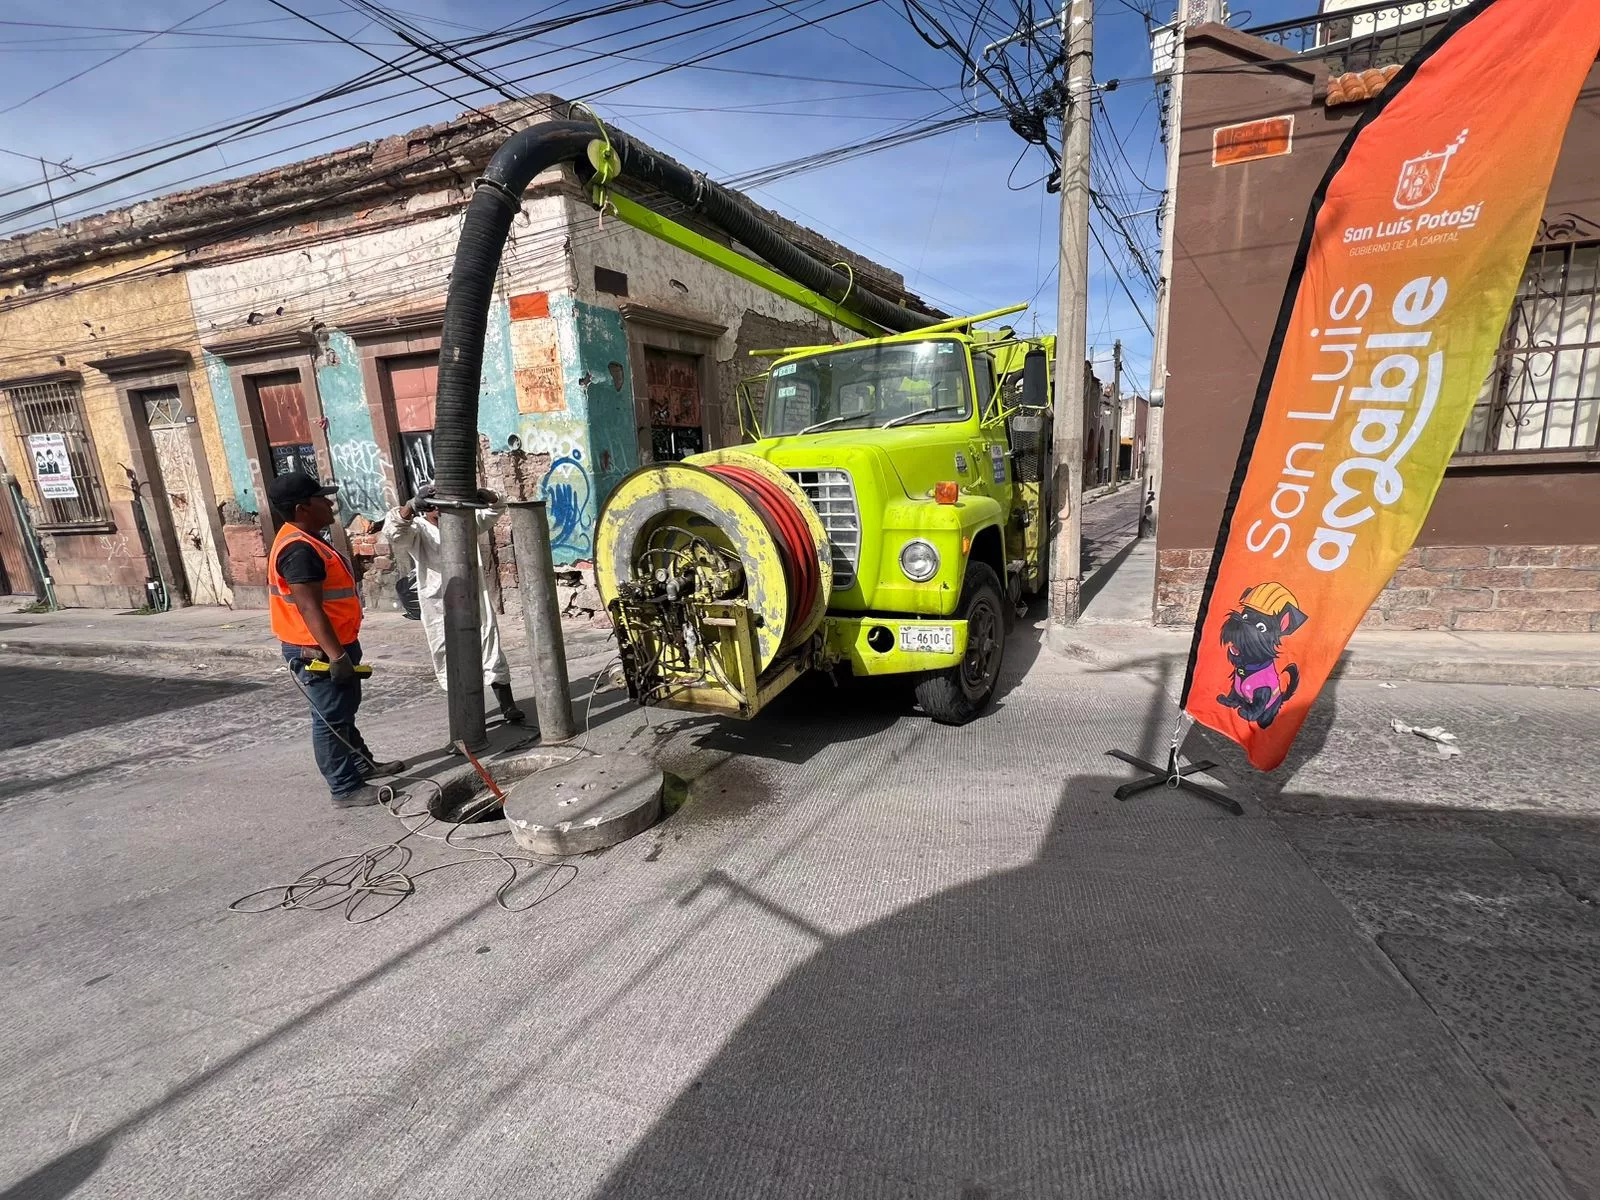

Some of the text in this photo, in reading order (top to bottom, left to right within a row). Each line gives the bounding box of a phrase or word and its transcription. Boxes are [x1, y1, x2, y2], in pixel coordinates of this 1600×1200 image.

[1343, 226, 1374, 243] San
[1376, 216, 1412, 238] Luis
[1349, 232, 1459, 256] GOBIERNO DE LA CAPITAL
[1246, 283, 1373, 558] San Luis
[1306, 275, 1448, 572] amable
[901, 632, 951, 645] TL-4610-C
